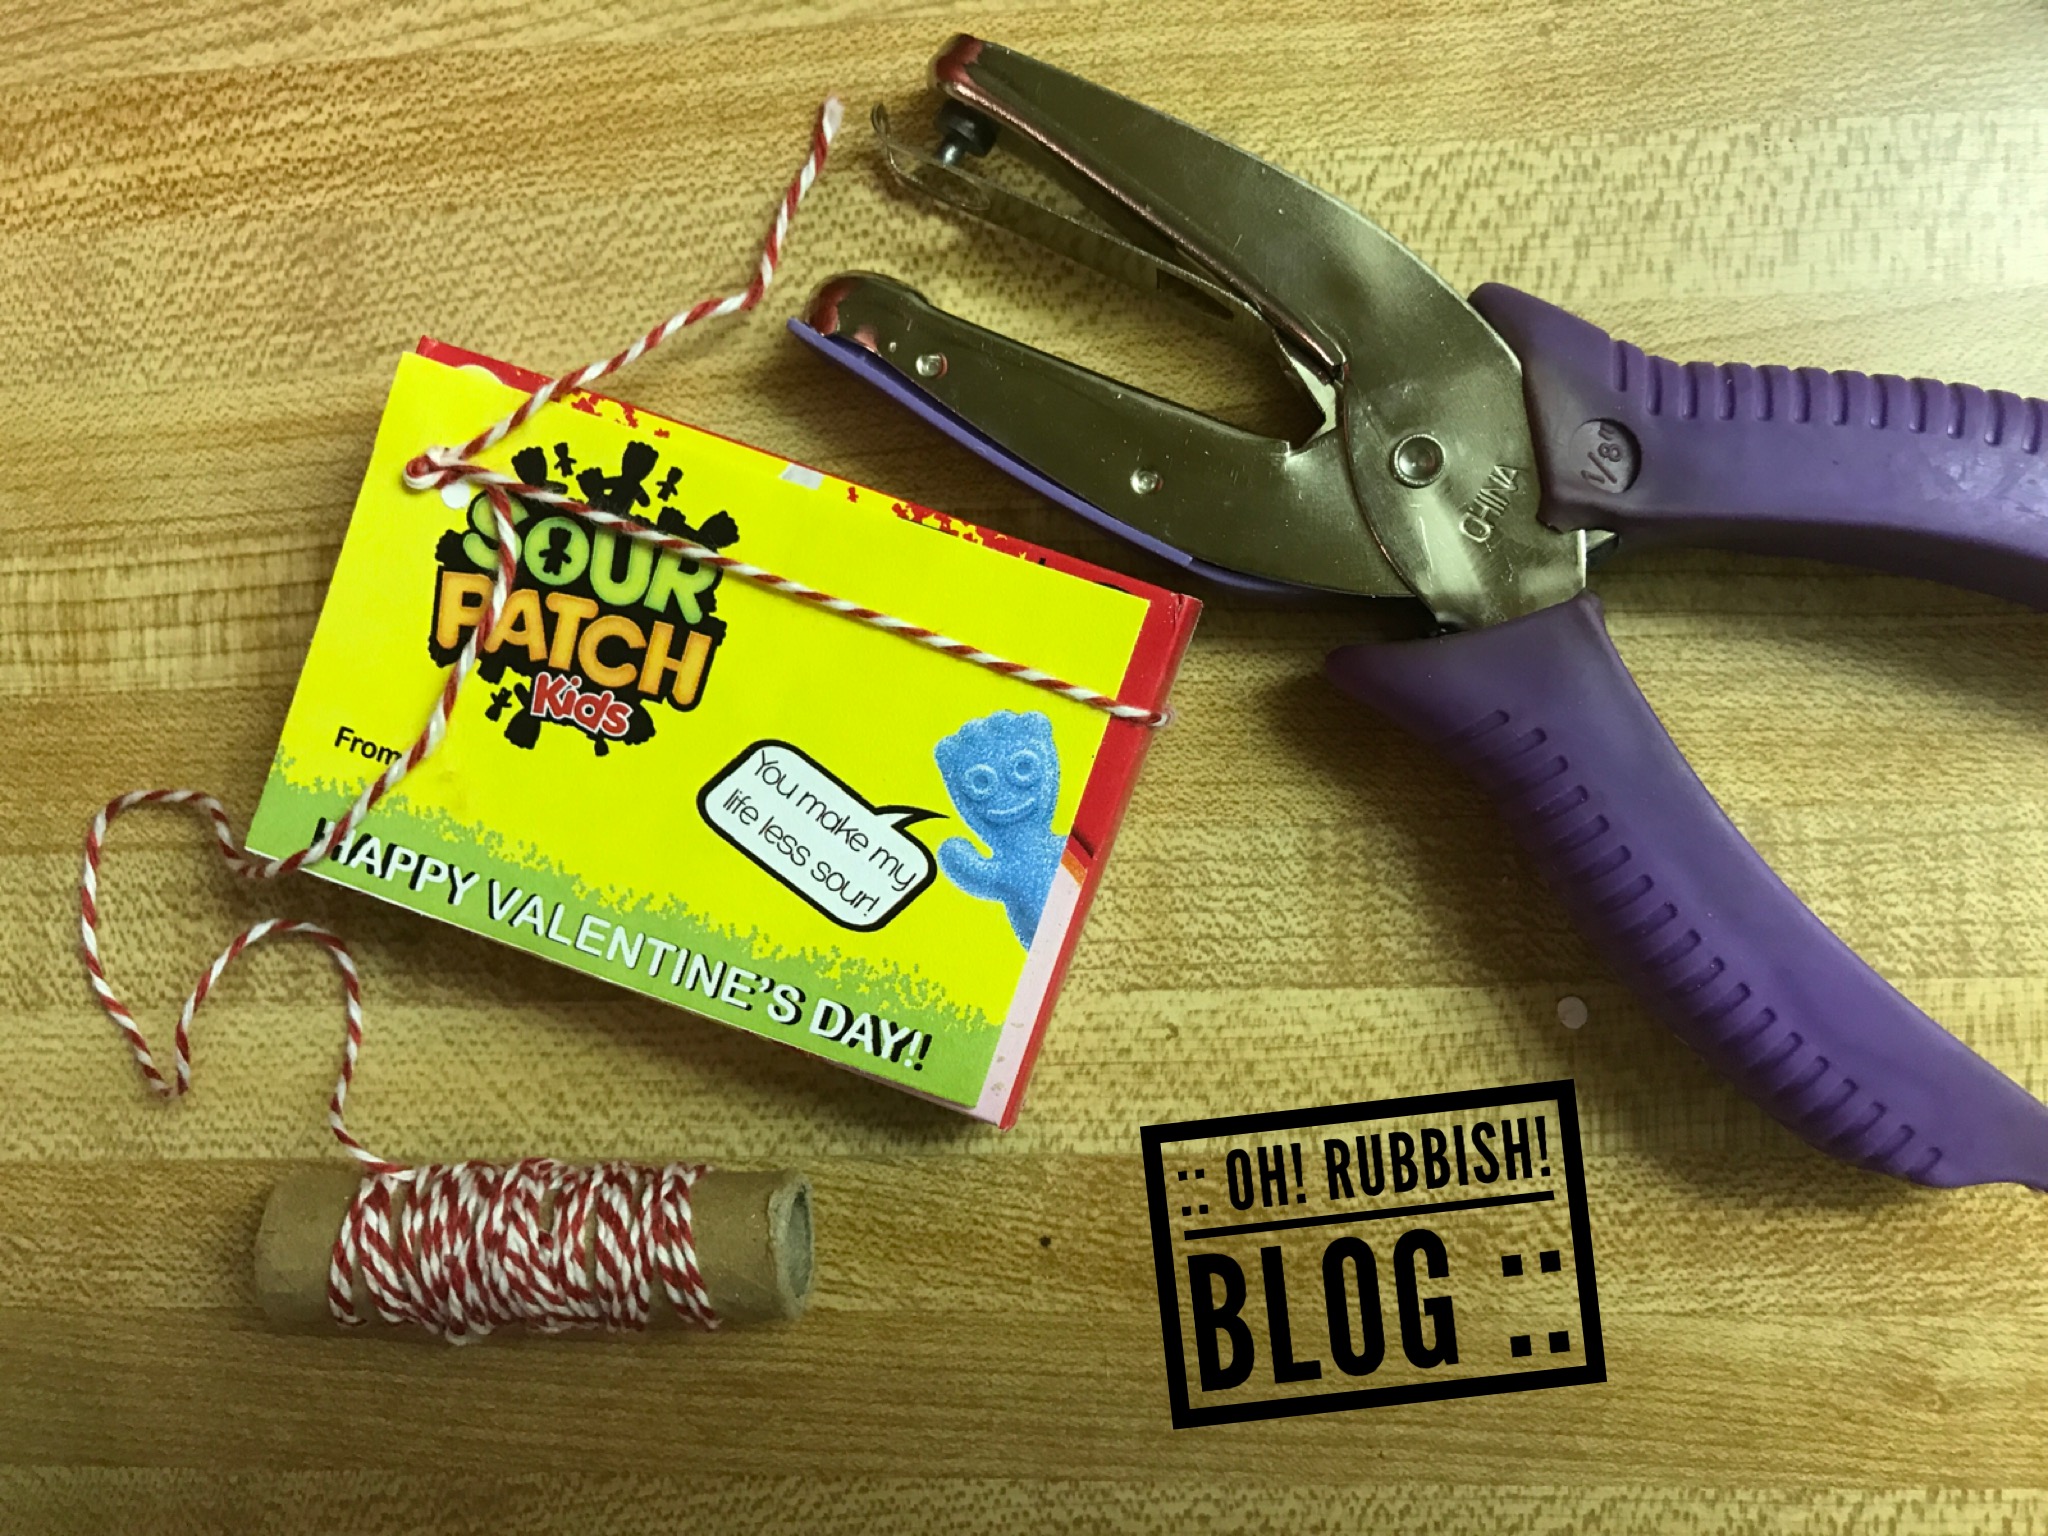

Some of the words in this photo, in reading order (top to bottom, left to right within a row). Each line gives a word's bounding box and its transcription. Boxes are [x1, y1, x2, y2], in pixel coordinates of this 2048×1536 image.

[463, 492, 720, 624] SOUR
[1459, 465, 1520, 543] CHINA
[436, 571, 713, 706] PATCH
[334, 726, 403, 765] From
[531, 672, 633, 737] Kids
[722, 788, 759, 826] life
[759, 816, 811, 867] less
[810, 860, 880, 917] sour!
[753, 750, 800, 800] You
[795, 790, 869, 853] make
[868, 846, 917, 892] my
[312, 817, 480, 906] HAPPY
[488, 878, 806, 1026] VALENTINE'S
